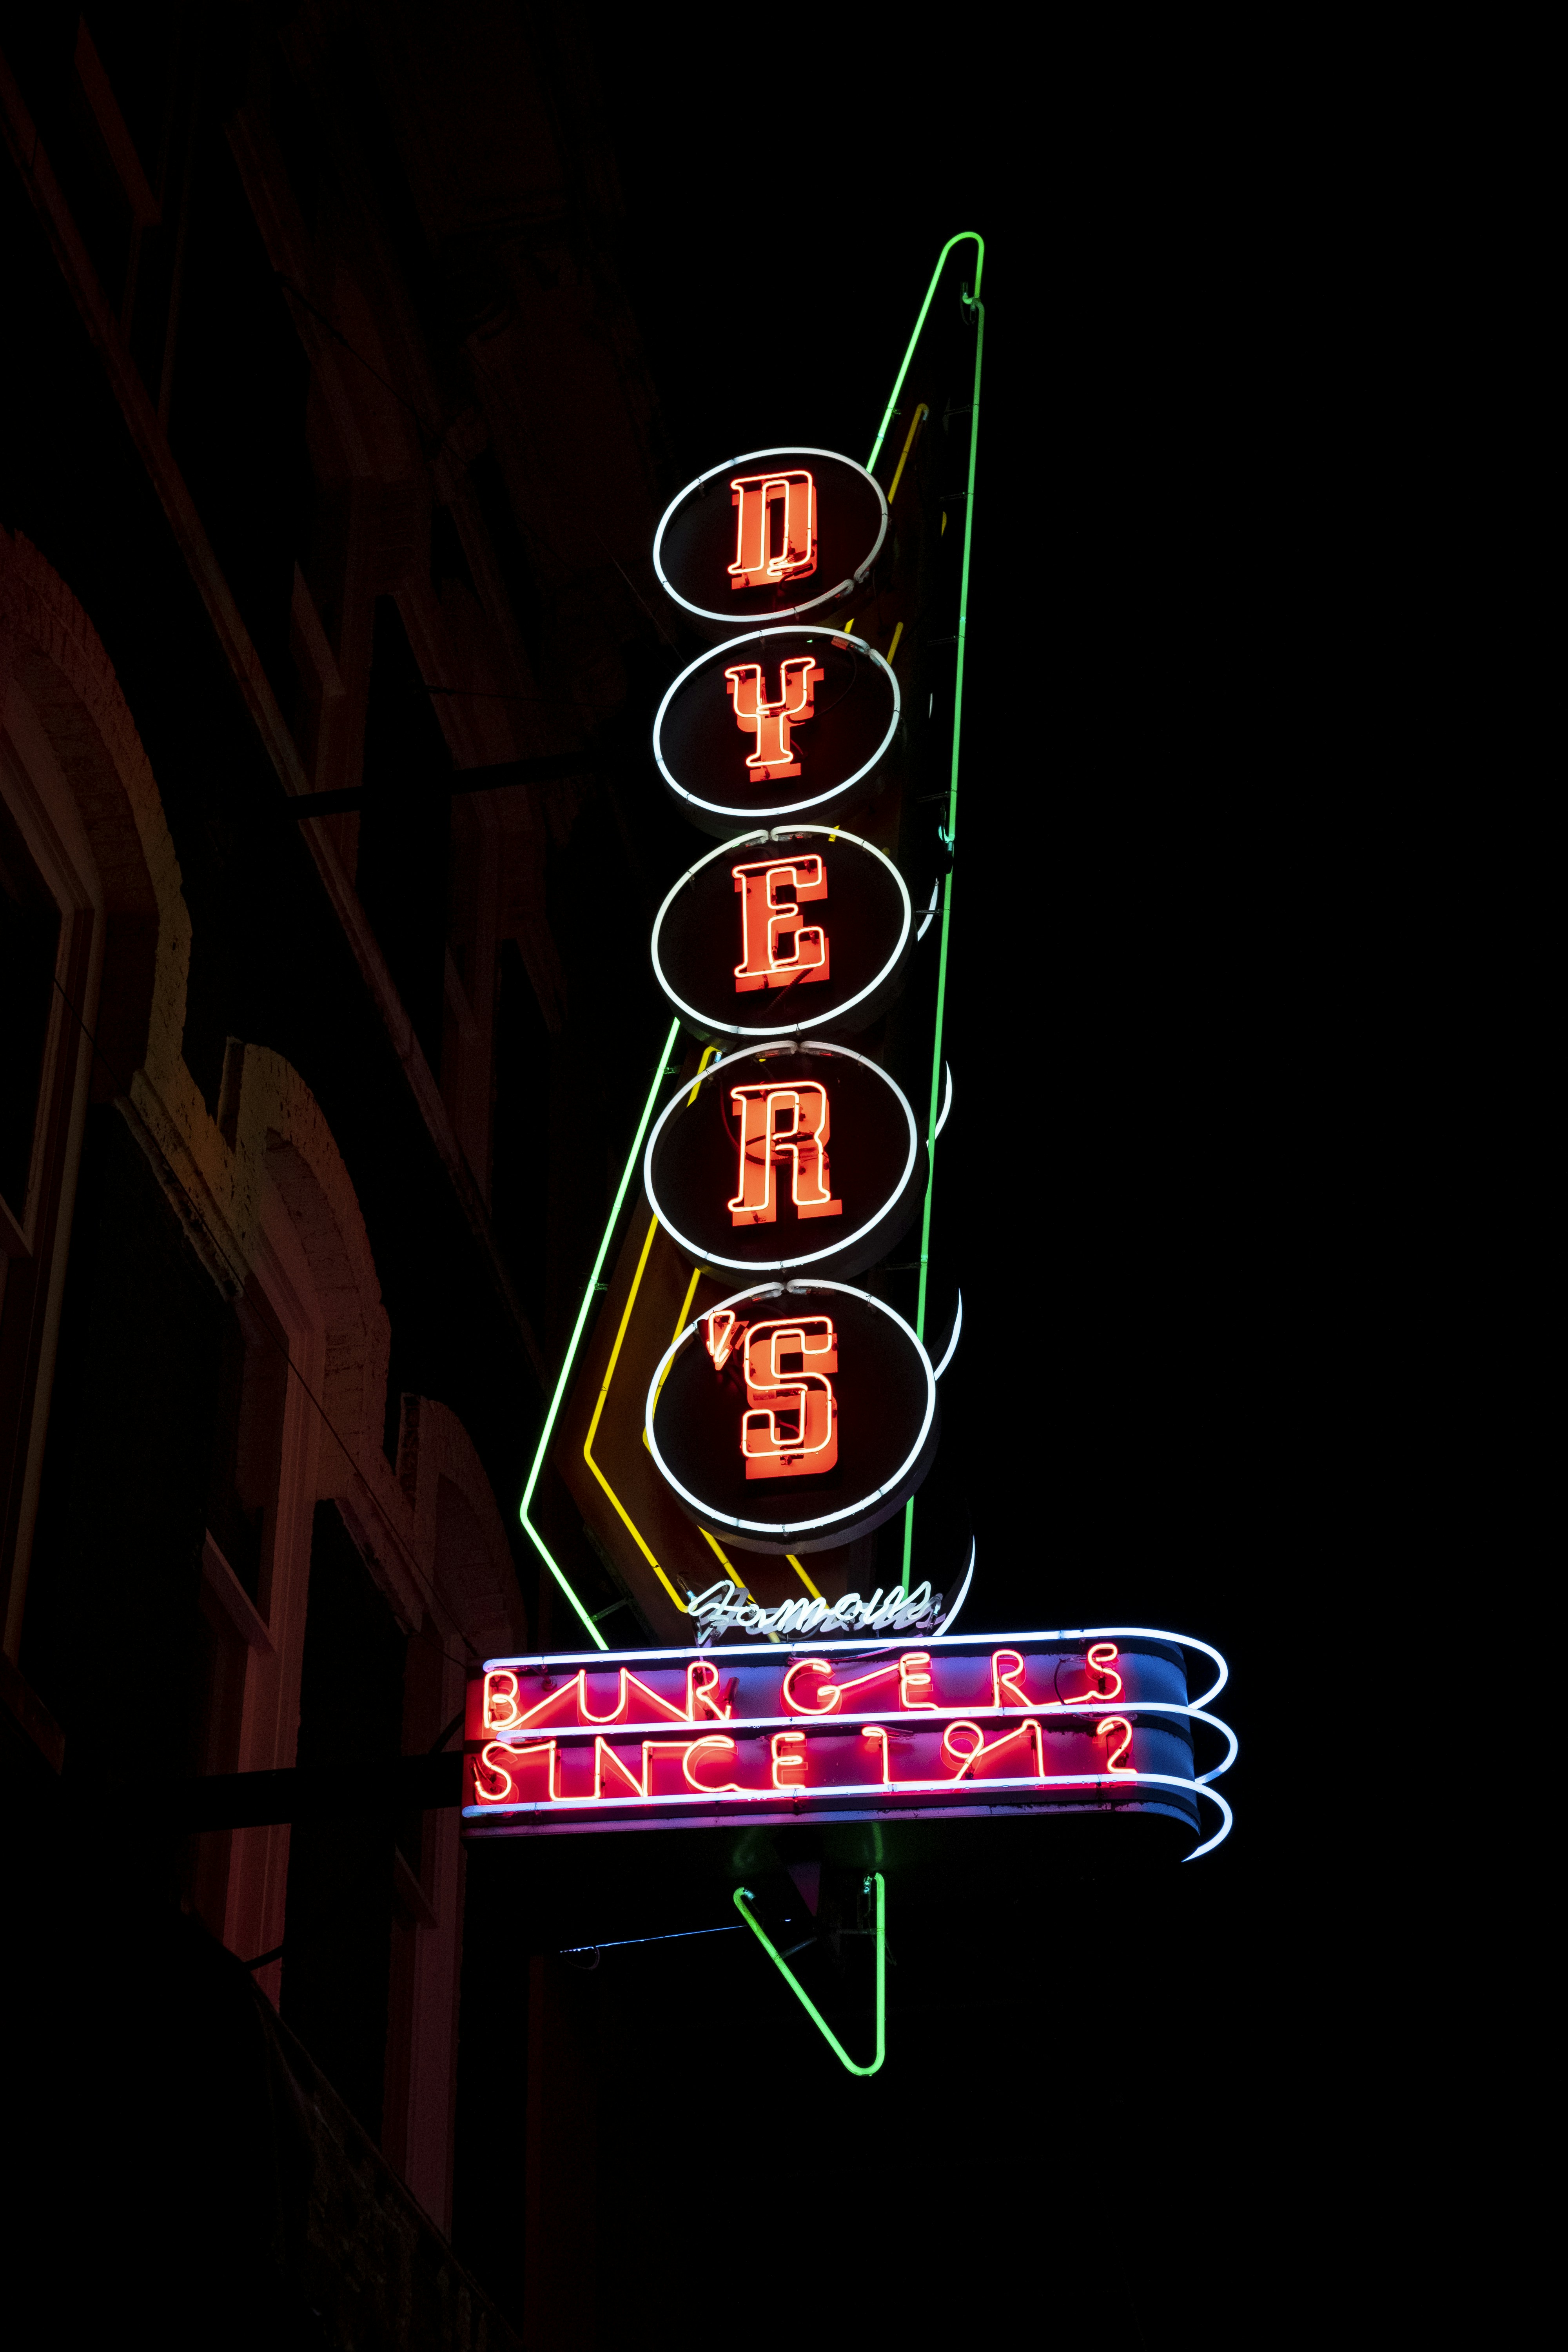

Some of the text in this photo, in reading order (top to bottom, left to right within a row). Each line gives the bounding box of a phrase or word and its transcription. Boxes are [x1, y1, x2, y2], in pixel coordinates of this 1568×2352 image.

[704, 470, 841, 1479] DYER'S
[688, 1579, 945, 1645] Famous
[484, 1643, 1123, 1731] BURGERS
[475, 1715, 1138, 1802] SINCE 1912
